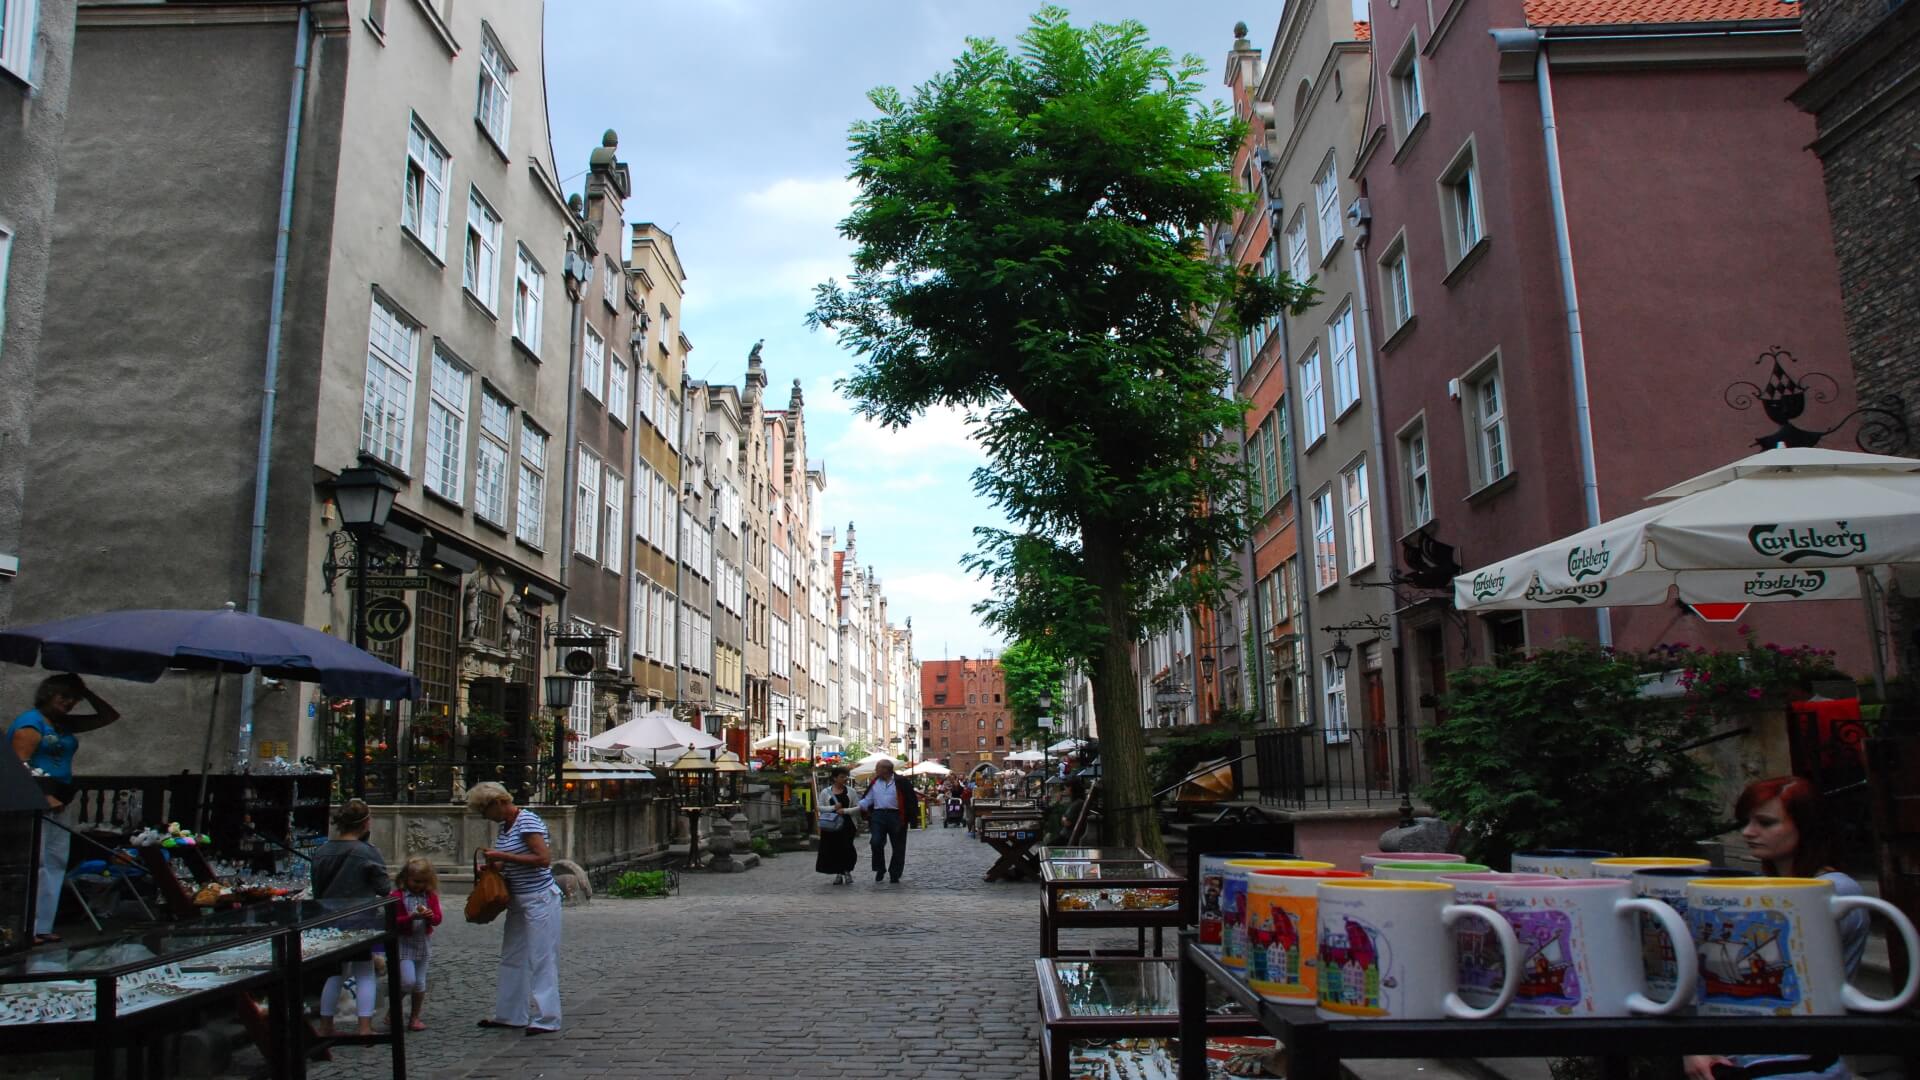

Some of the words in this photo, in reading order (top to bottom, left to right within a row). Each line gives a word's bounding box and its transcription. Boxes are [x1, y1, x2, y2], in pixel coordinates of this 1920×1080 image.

[1568, 541, 1609, 581] Carlsberg
[1748, 521, 1866, 562] Carlsberg
[1473, 568, 1504, 600] Carlsberg
